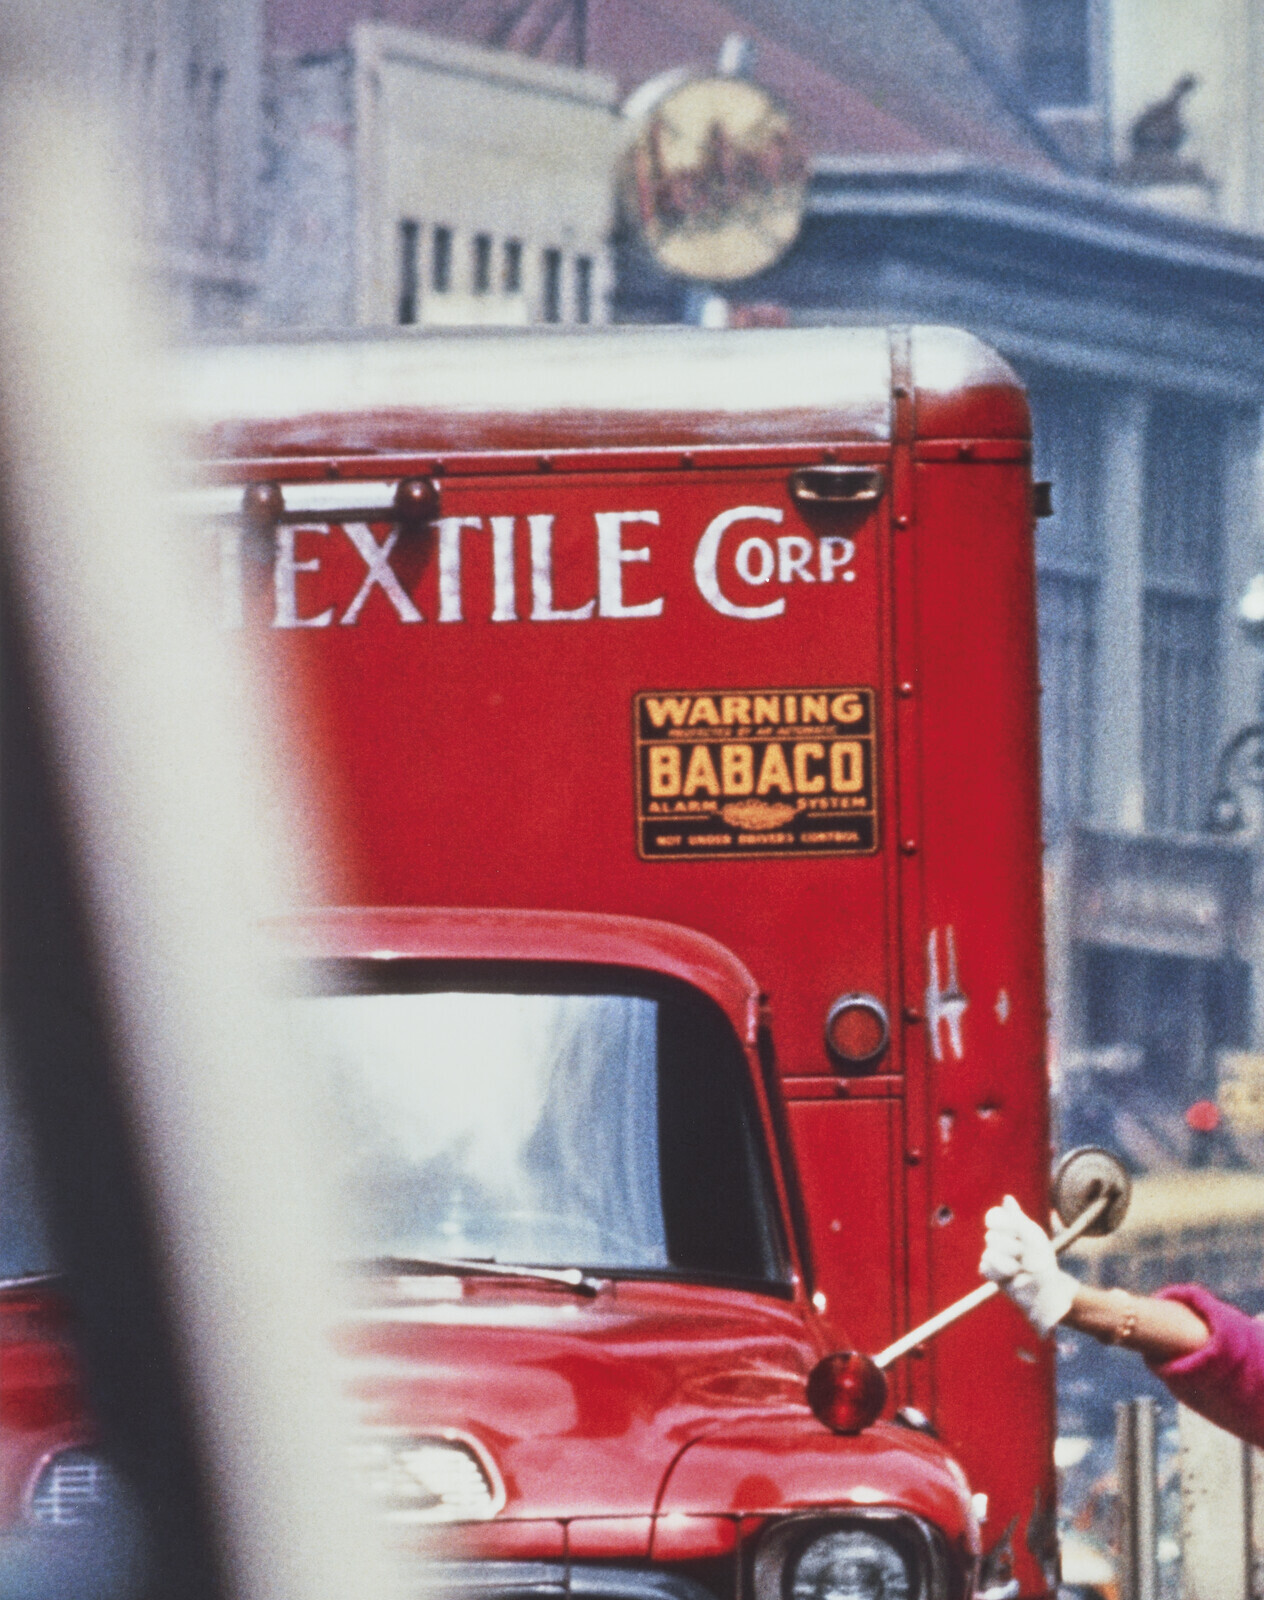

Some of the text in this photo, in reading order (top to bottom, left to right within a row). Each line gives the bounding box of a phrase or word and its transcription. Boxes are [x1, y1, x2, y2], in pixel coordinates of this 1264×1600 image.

[646, 694, 863, 727] WARNING
[650, 742, 863, 796] BABACO
[648, 797, 867, 813] ALARM SYSTEM
